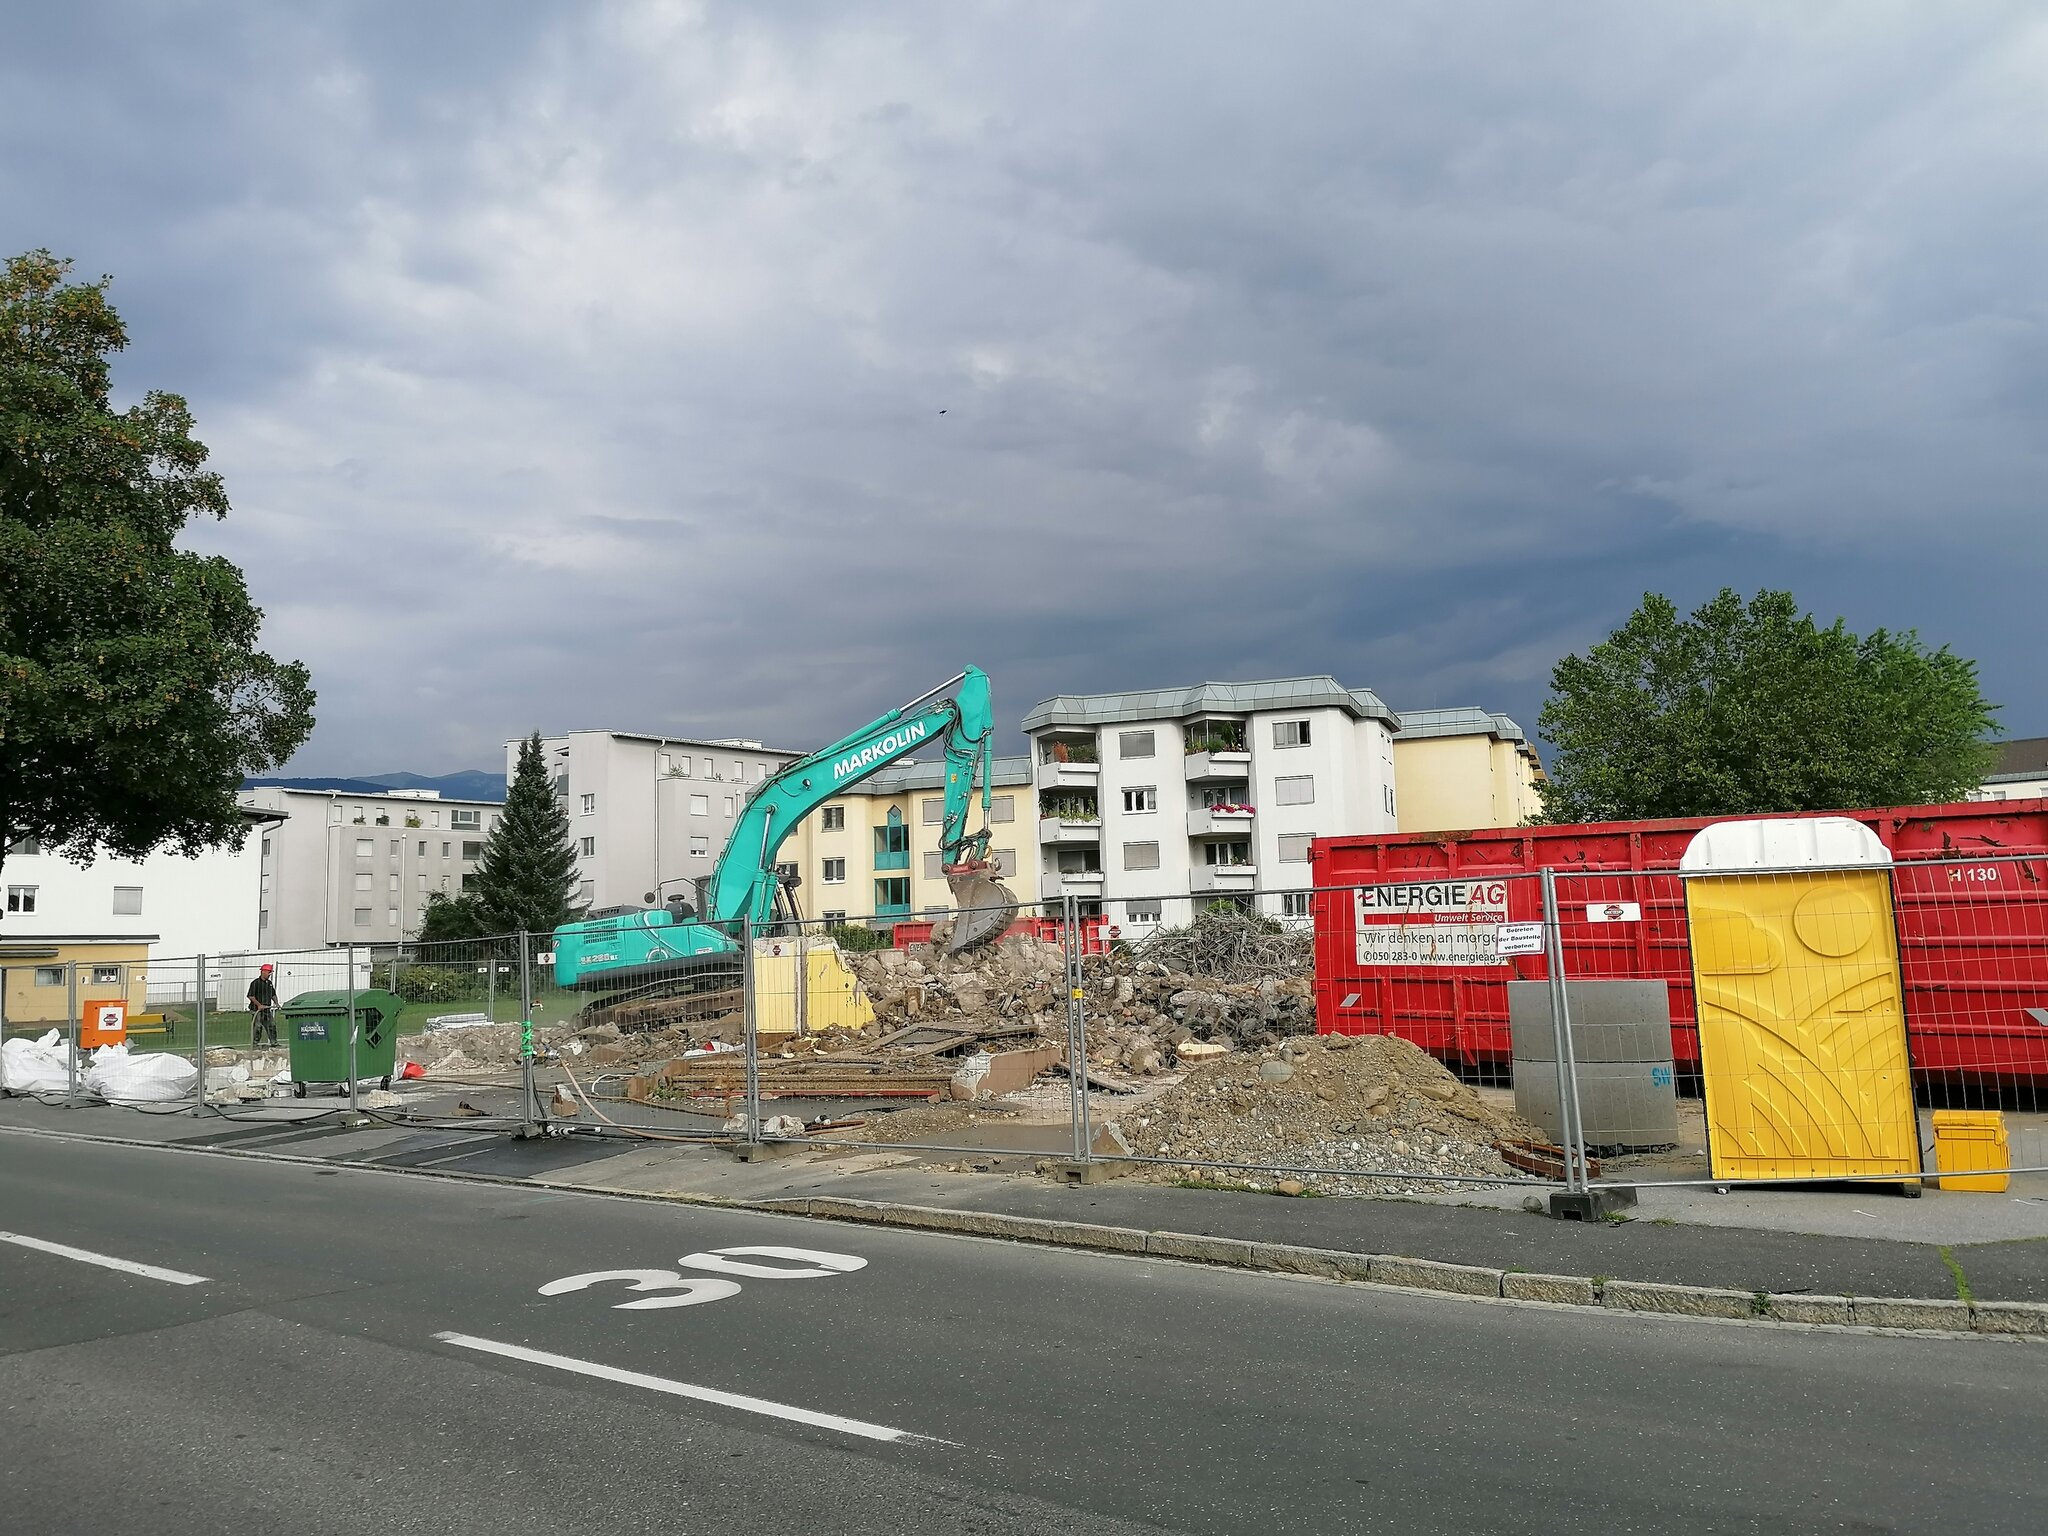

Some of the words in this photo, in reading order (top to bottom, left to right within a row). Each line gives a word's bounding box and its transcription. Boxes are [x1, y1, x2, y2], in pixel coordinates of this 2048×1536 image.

[834, 721, 925, 780] MARKOLIN
[1949, 868, 1961, 881] H
[1967, 867, 1997, 882] 130
[1434, 913, 1468, 922] Umwelt
[1471, 912, 1503, 922] Service
[1364, 931, 1385, 944] Wir
[1389, 931, 1434, 944] denken
[1438, 933, 1453, 944] an
[1457, 932, 1497, 946] morge
[1373, 951, 1389, 961] 050
[1392, 951, 1417, 962] 283-0
[1652, 1066, 1670, 1087] SW
[537, 1246, 868, 1310] 30
